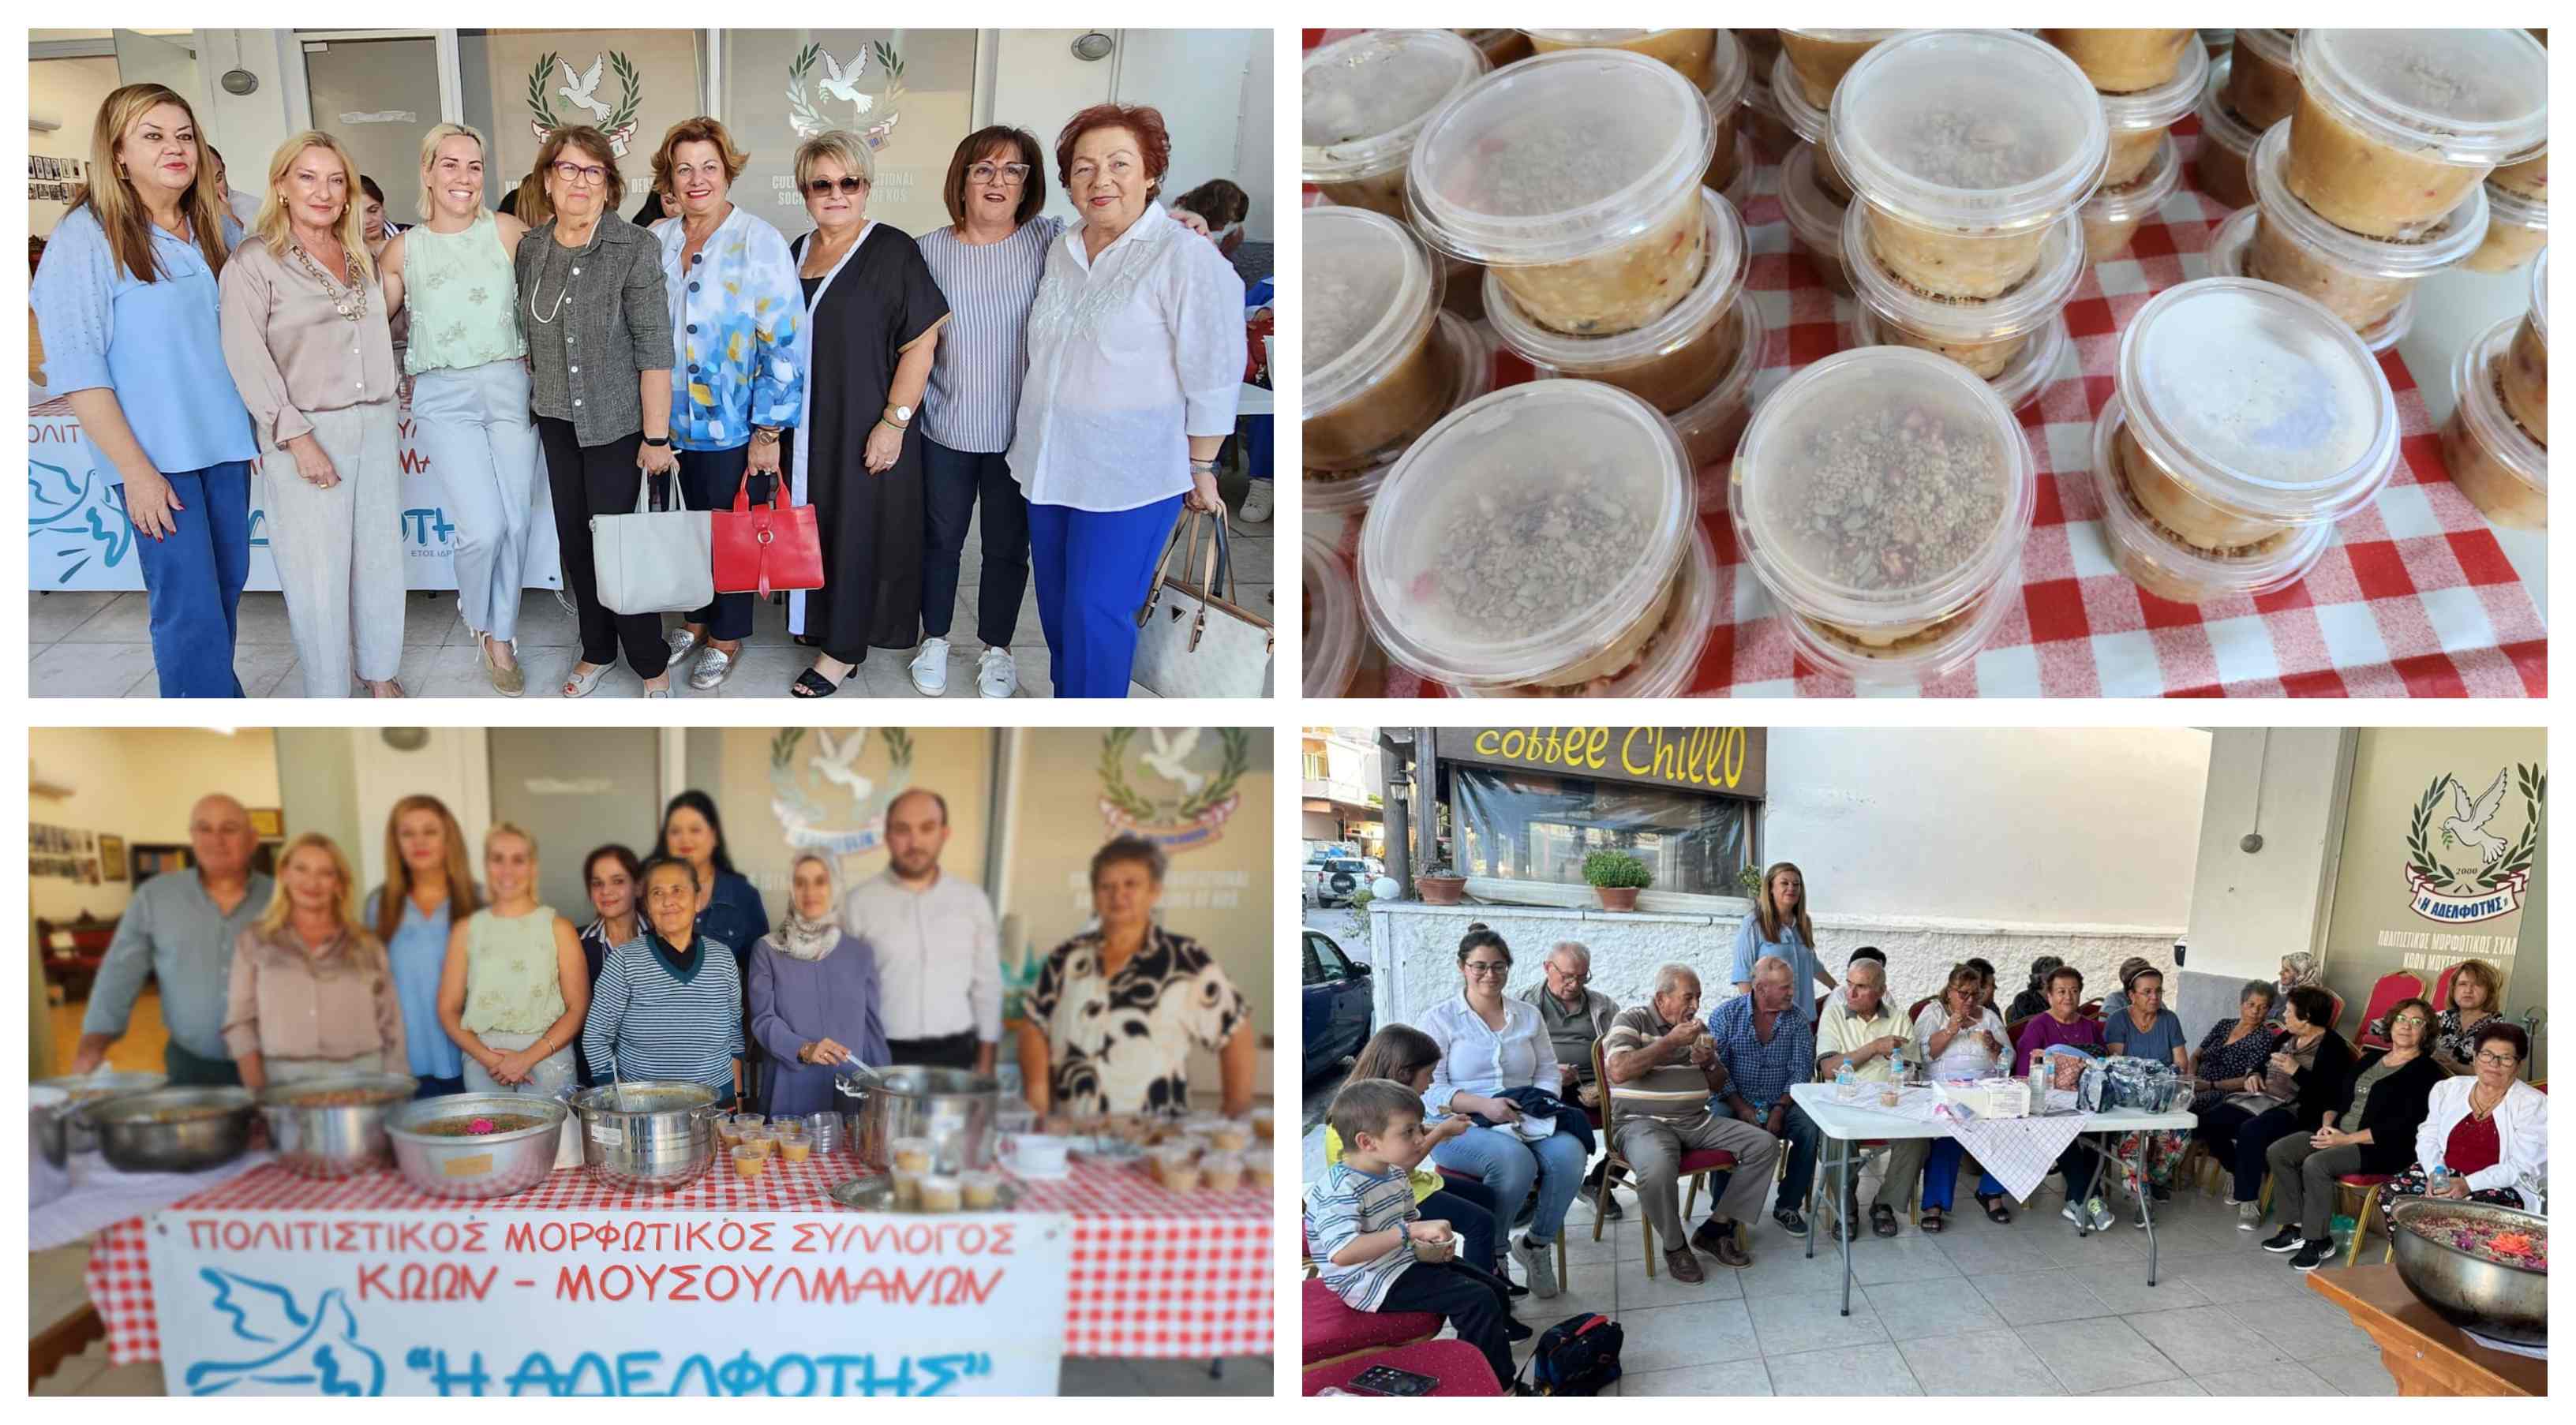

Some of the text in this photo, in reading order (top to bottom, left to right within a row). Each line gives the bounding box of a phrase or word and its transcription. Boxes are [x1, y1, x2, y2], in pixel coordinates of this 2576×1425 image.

[2455, 867, 2478, 876] 2000
[189, 1219, 1017, 1255] ΠΟΛΙΤΙΣΤΙΚΟΣ ΜΟΡΦΩΤΙΚΟΣ ΣΥΛΛΟΓΟΣ
[358, 1263, 499, 1301] ΚΩΩΝ
[556, 1264, 1005, 1306] ΜΟΥΣΟΥΛΜΑΝΩΝ
